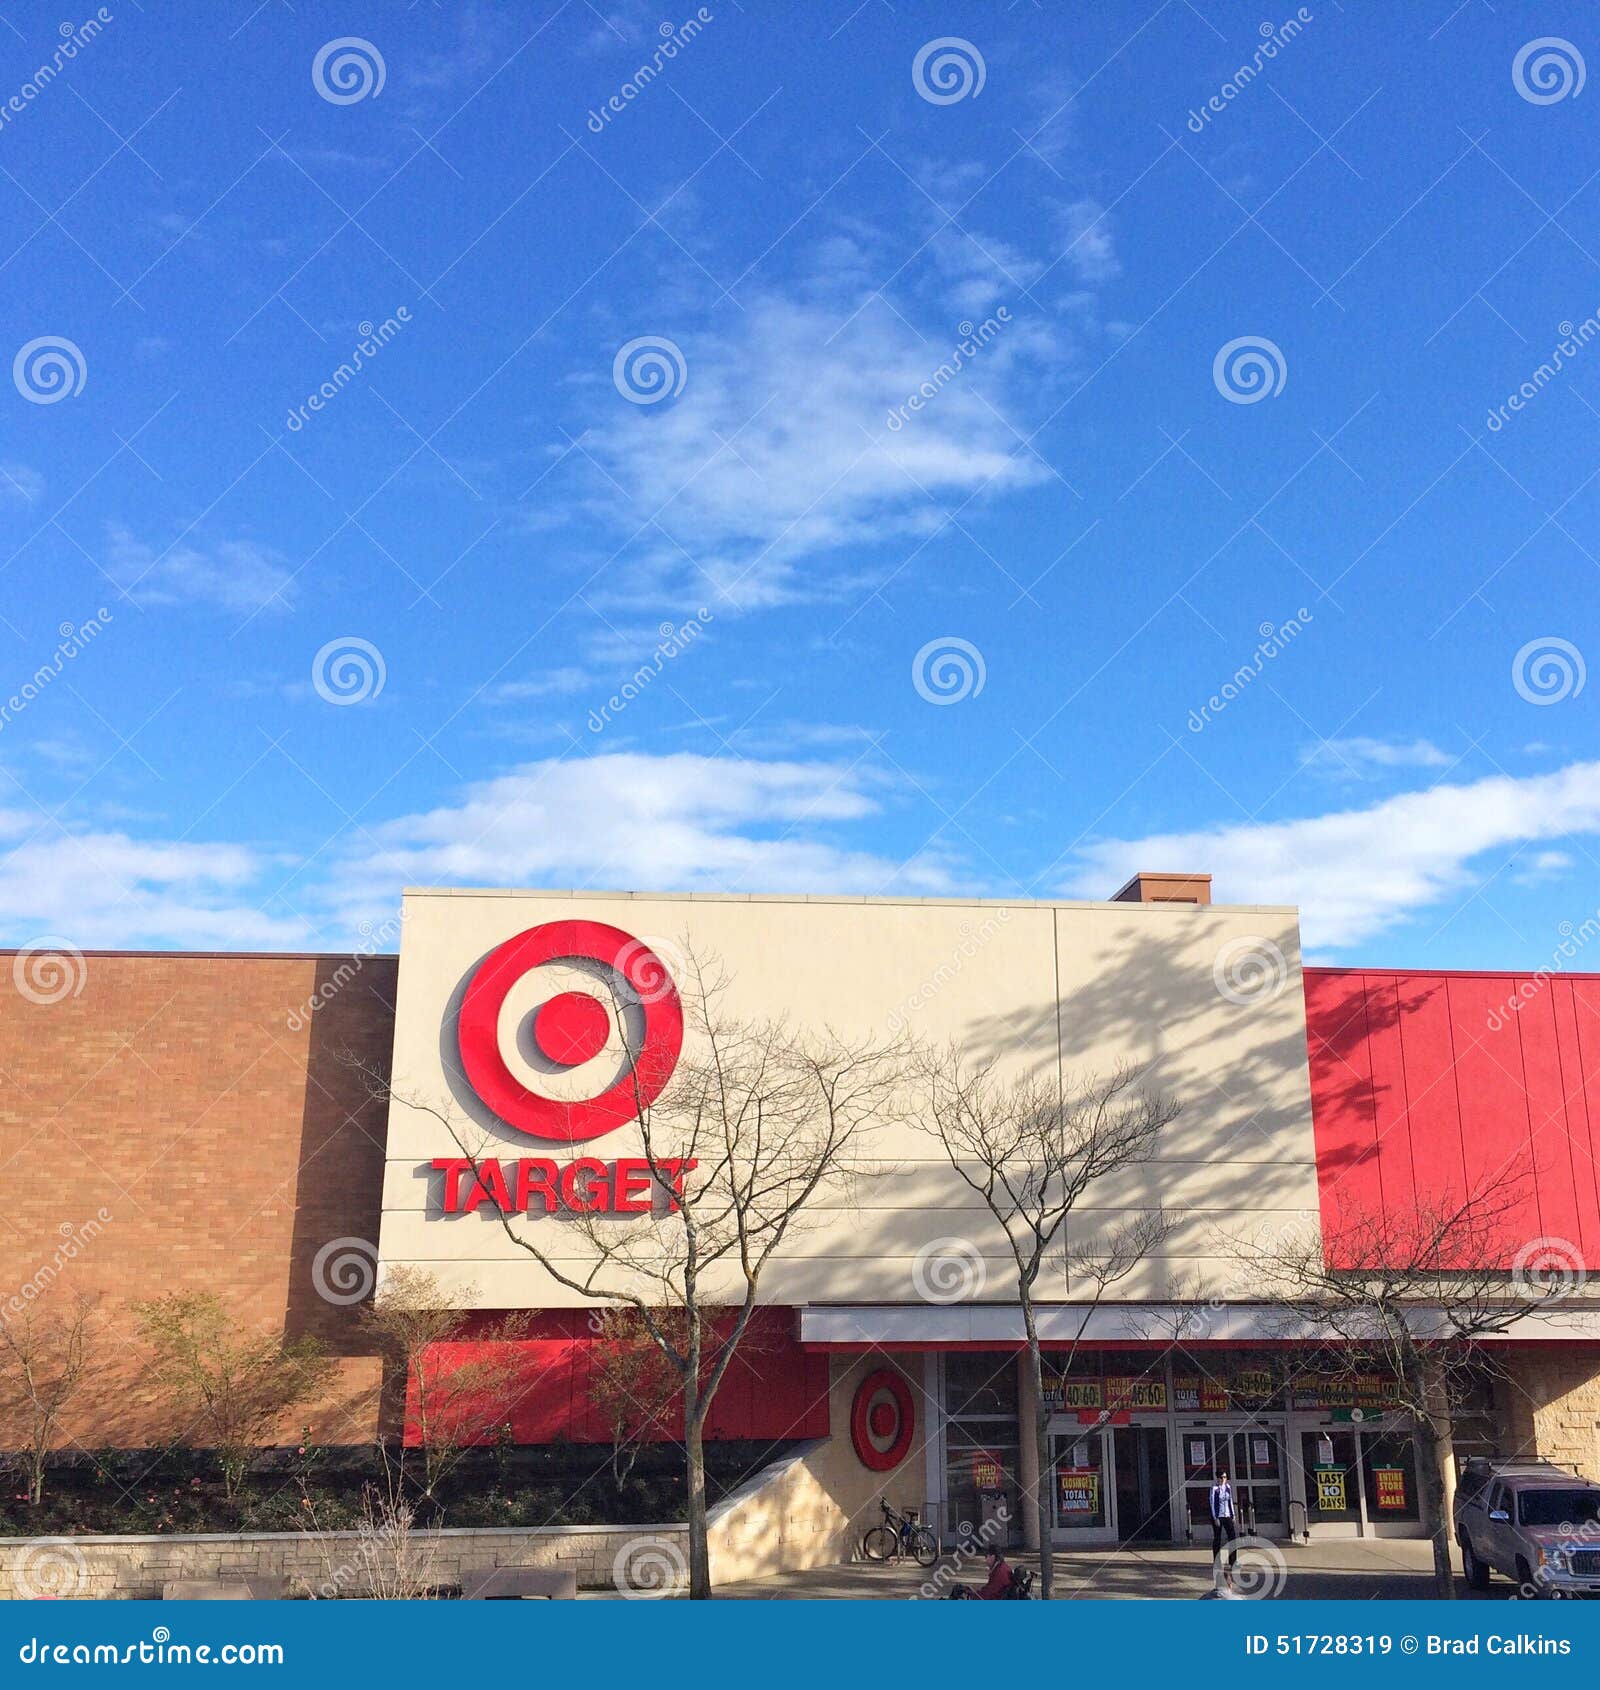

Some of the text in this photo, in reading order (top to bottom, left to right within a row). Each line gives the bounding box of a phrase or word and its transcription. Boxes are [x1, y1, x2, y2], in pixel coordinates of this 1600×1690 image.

[432, 1157, 698, 1212] TARGET
[1176, 1390, 1198, 1400] TOTAL
[1319, 1473, 1342, 1484] LAST
[1379, 1473, 1403, 1481] ENTIRE
[1323, 1486, 1340, 1496] 10
[1380, 1482, 1403, 1490] STORE
[1064, 1490, 1086, 1500] TOTAL
[1320, 1497, 1344, 1508] DAYS!
[1380, 1496, 1405, 1505] SALE!
